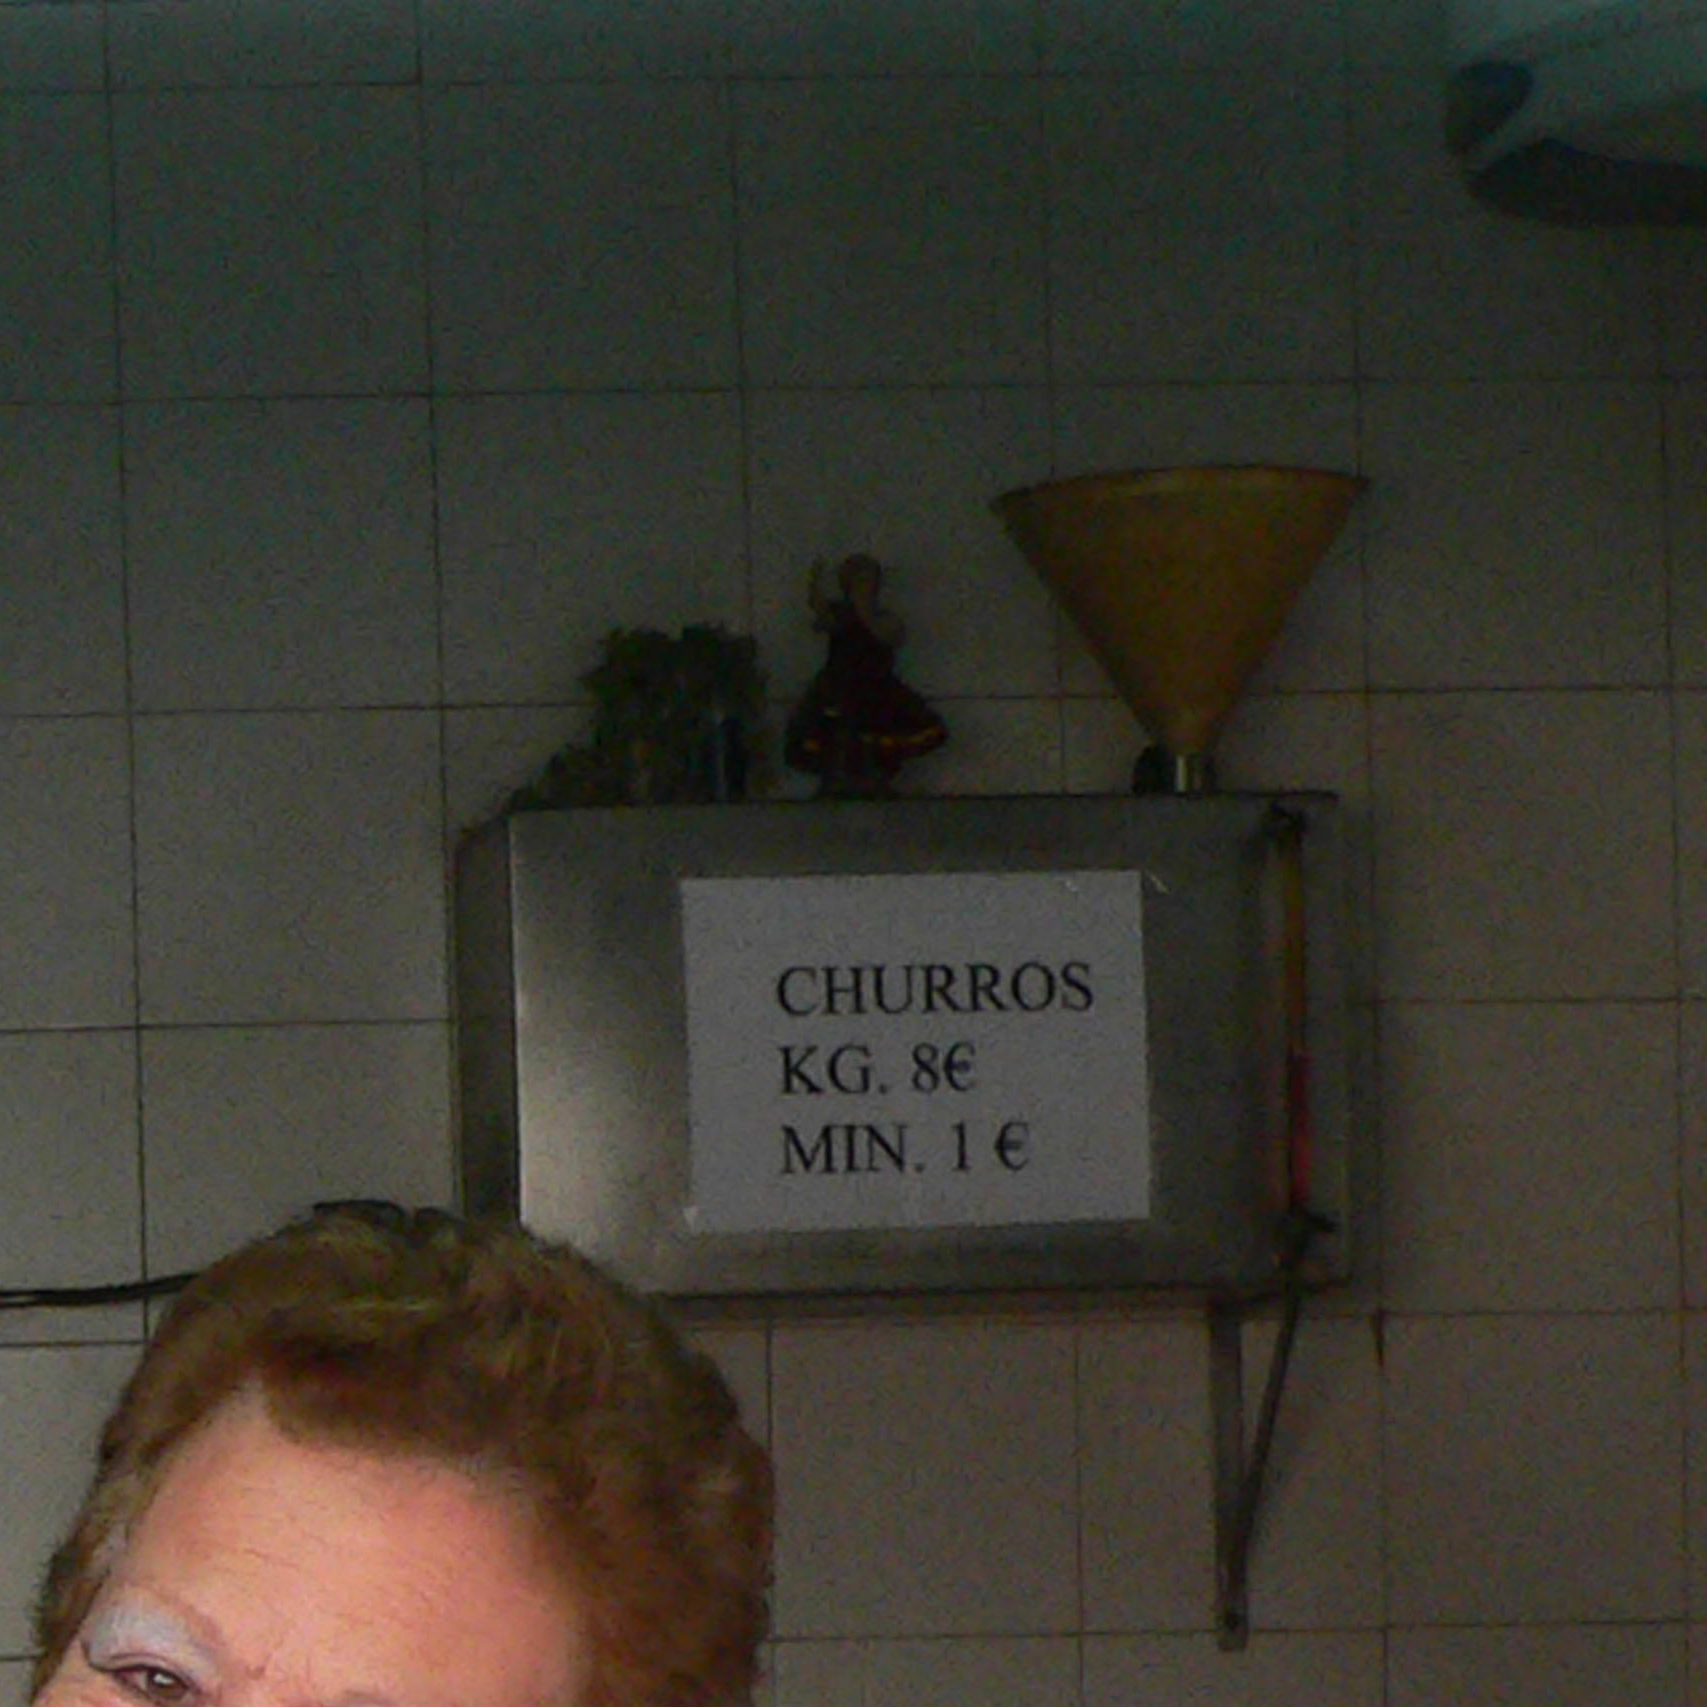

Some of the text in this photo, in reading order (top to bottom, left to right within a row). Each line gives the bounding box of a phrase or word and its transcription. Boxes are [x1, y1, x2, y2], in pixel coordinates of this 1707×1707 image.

[777, 962, 1094, 1017] CHURROS
[779, 1043, 977, 1096] KG. 8€
[781, 1121, 1030, 1175] MIN. 1 €
